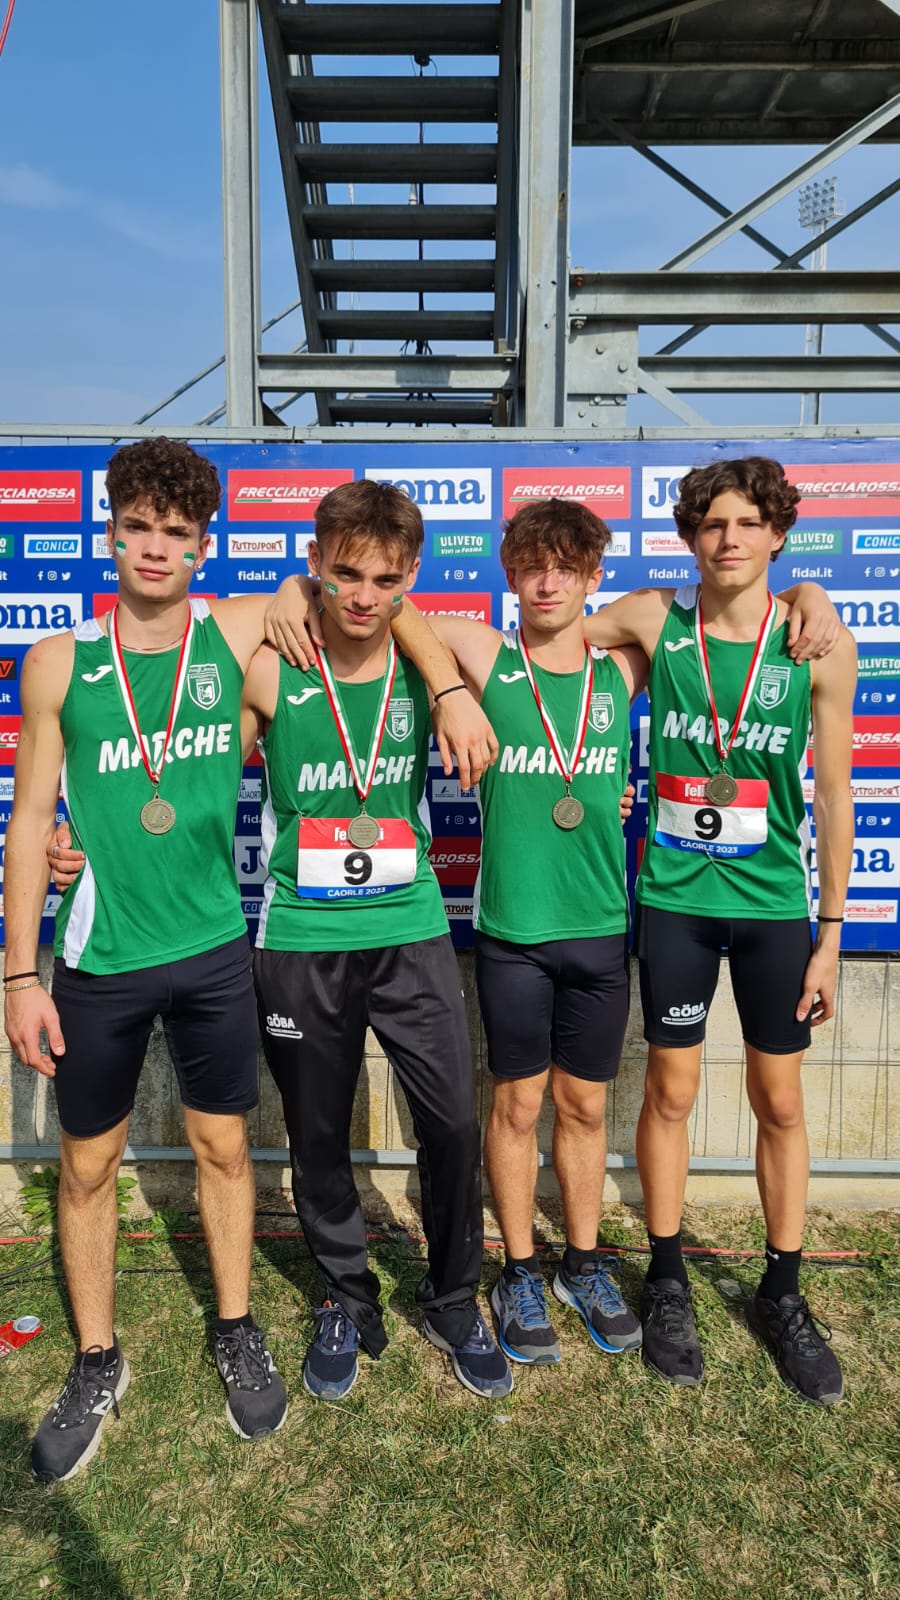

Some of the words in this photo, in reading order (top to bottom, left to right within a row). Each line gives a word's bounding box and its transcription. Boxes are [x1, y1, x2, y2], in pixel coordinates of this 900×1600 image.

[377, 479, 486, 504] oma
[512, 485, 625, 496] FRECCIAROSSA
[795, 482, 900, 493] FRECCIAROSS
[231, 539, 284, 551] TUTTOSPORT
[440, 535, 483, 547] ULIVETO
[790, 533, 835, 545] ULIVETO
[864, 536, 900, 547] CONIC
[35, 540, 75, 552] CONICA
[237, 570, 277, 581] fidal.it
[648, 568, 690, 580] fidal.it
[792, 567, 833, 578] fidal.it
[857, 657, 900, 670] ULIVETO
[662, 710, 792, 755] MARCHE
[98, 723, 233, 773] MARCHE
[694, 807, 723, 841] 9
[680, 840, 714, 852] CAORLE
[716, 845, 738, 854] 2023
[343, 851, 373, 886] 9
[327, 888, 363, 897] CAORLE
[365, 886, 387, 895] 2023
[669, 1001, 705, 1018] GÖBA
[266, 1012, 296, 1029] GÖBA
